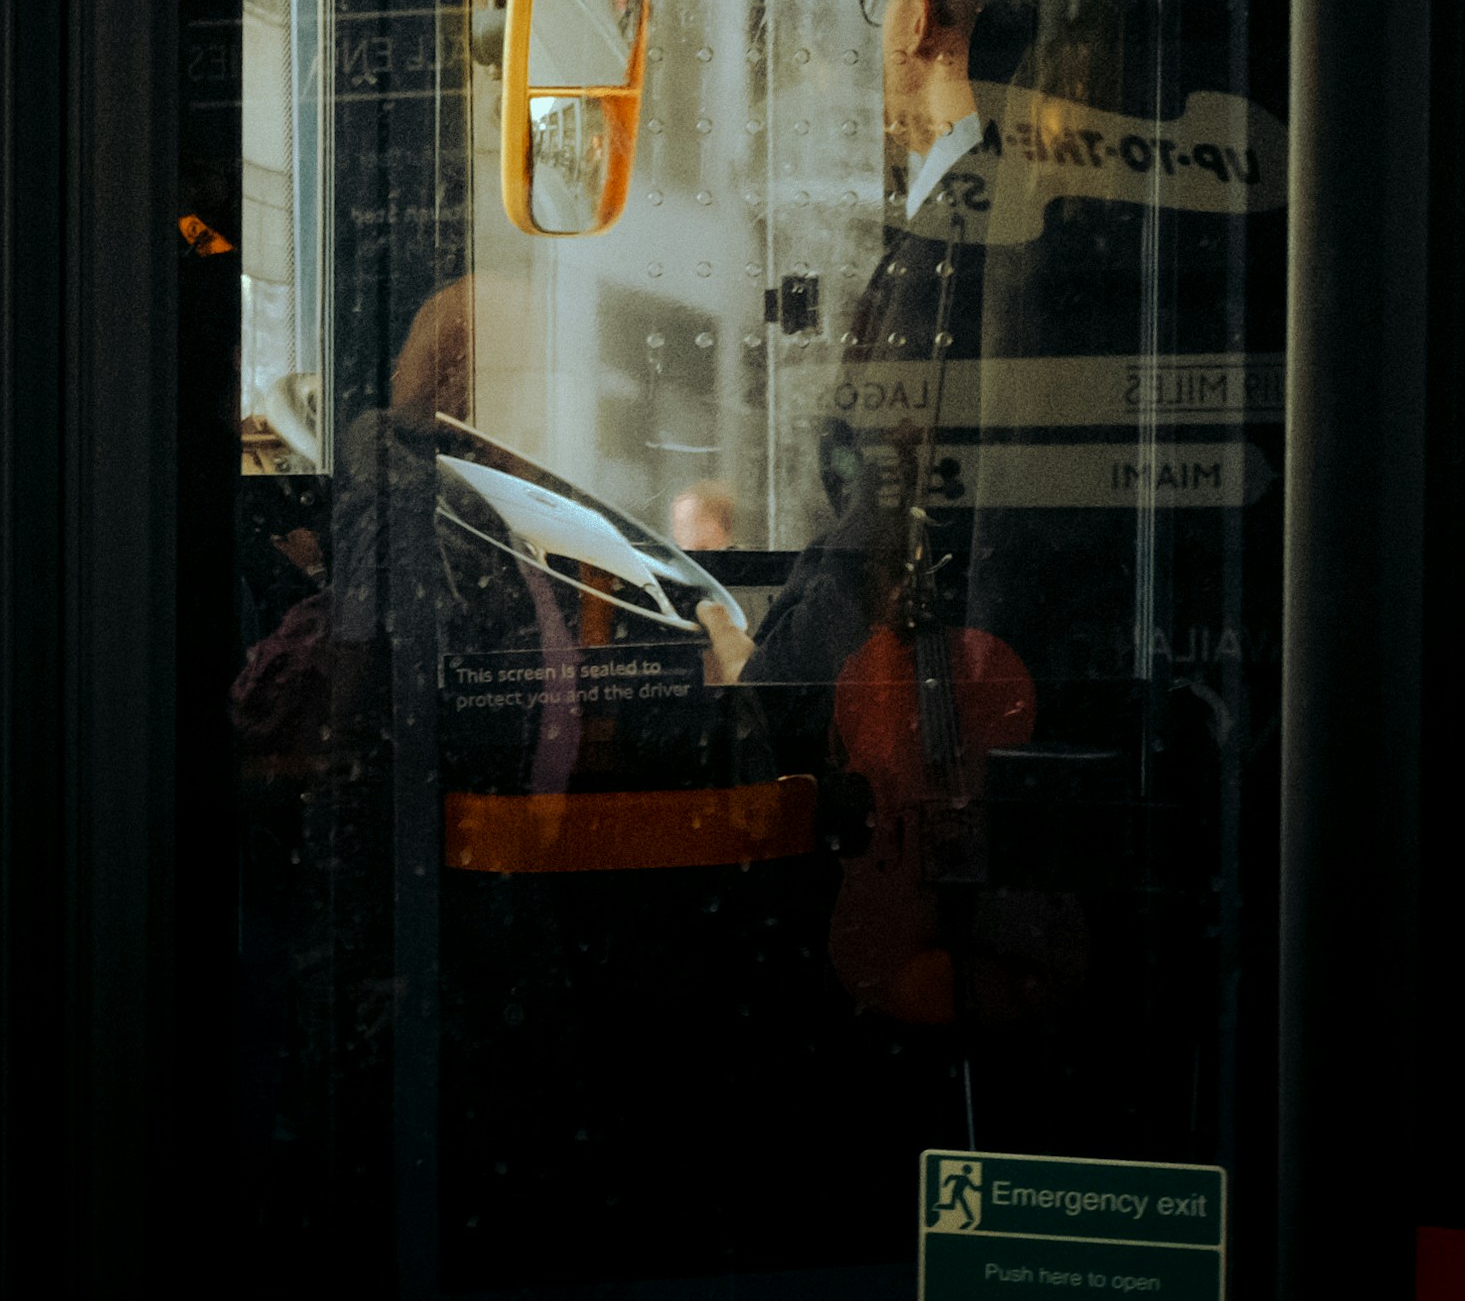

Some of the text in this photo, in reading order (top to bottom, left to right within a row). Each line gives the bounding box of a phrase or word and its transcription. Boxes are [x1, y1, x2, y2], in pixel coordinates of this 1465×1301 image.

[454, 667, 493, 685] This
[497, 665, 557, 684] screen
[579, 661, 638, 679] sealed
[641, 659, 662, 675] to
[454, 691, 524, 712] protect
[603, 682, 635, 701] the
[638, 681, 693, 699] driver
[990, 1180, 1208, 1220] Emergency exit
[984, 1262, 1161, 1295] Push here to open
